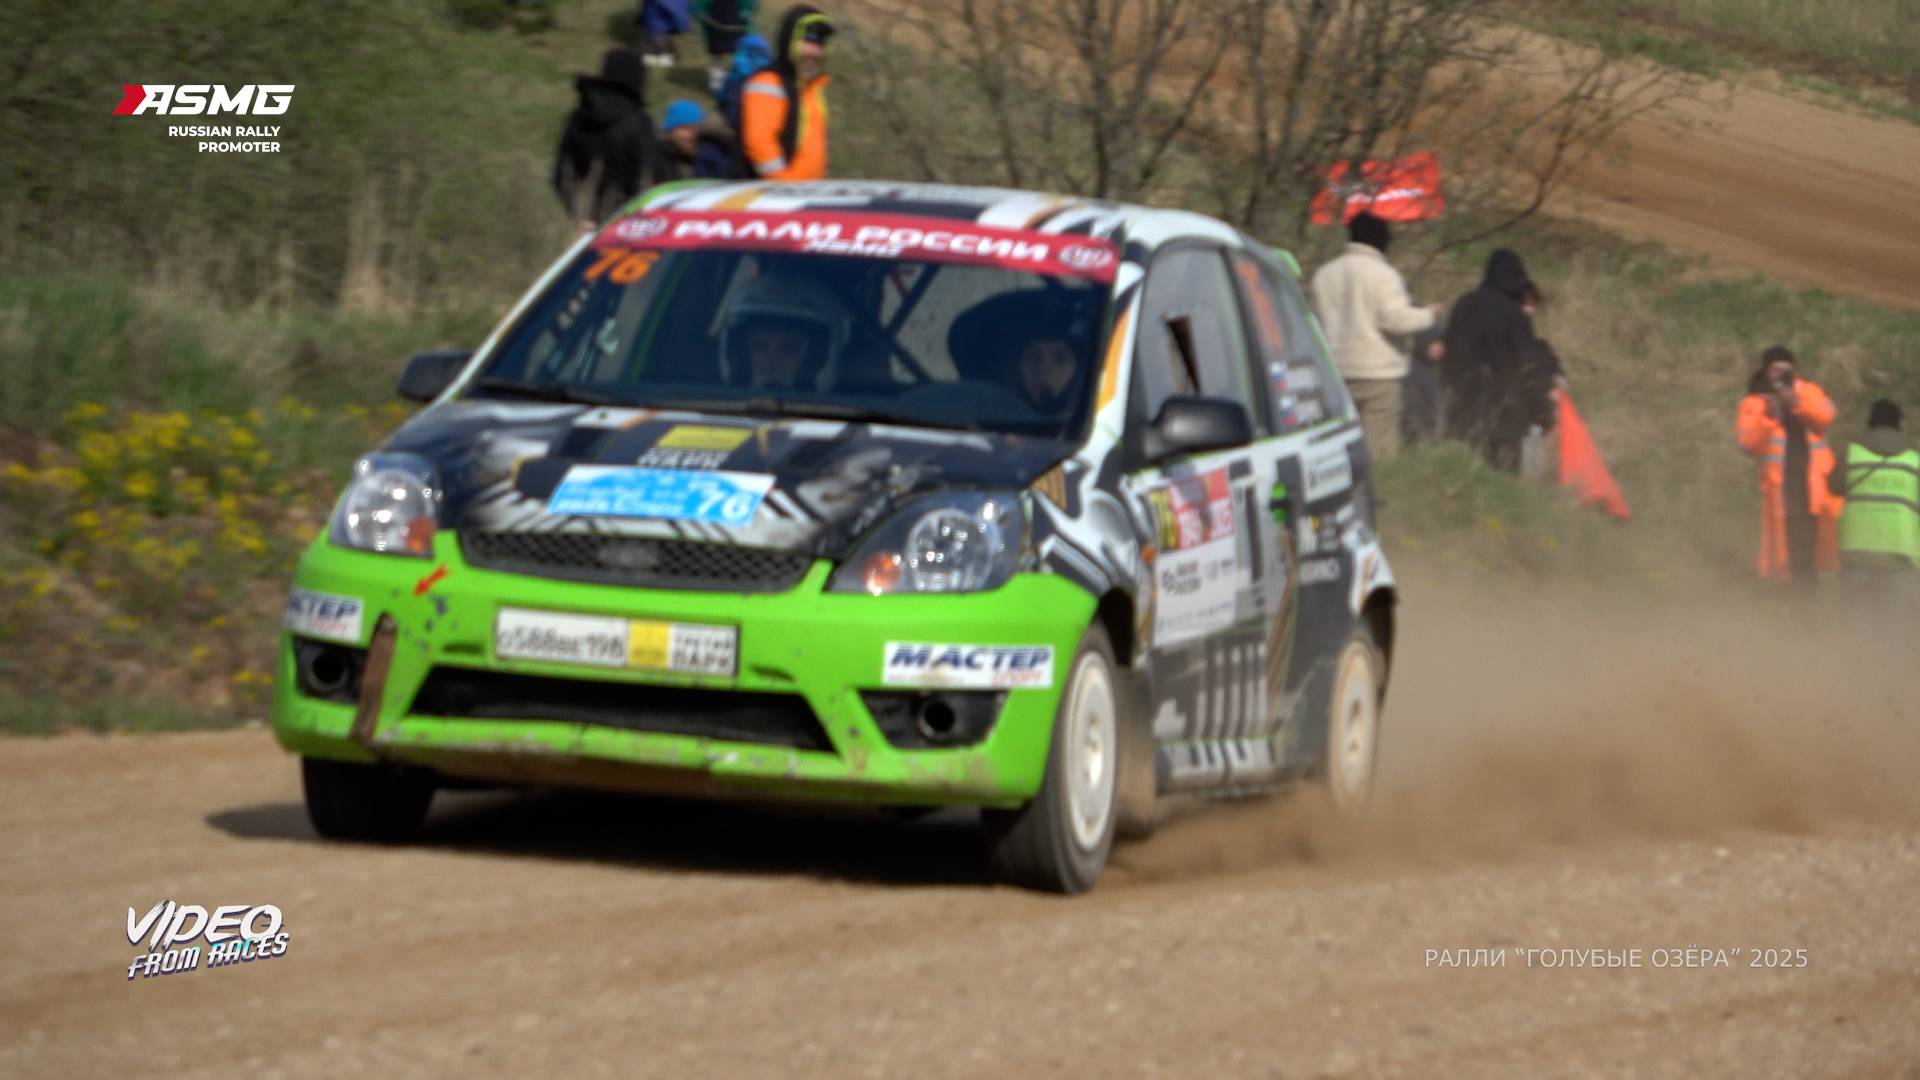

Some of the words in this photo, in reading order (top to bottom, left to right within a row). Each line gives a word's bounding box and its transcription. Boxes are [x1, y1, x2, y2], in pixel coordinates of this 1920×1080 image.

[672, 219, 842, 245] РАЛЛИ
[857, 226, 1050, 262] РОССИИ
[583, 247, 661, 285] 76
[891, 645, 1051, 670] МАСТЕР
